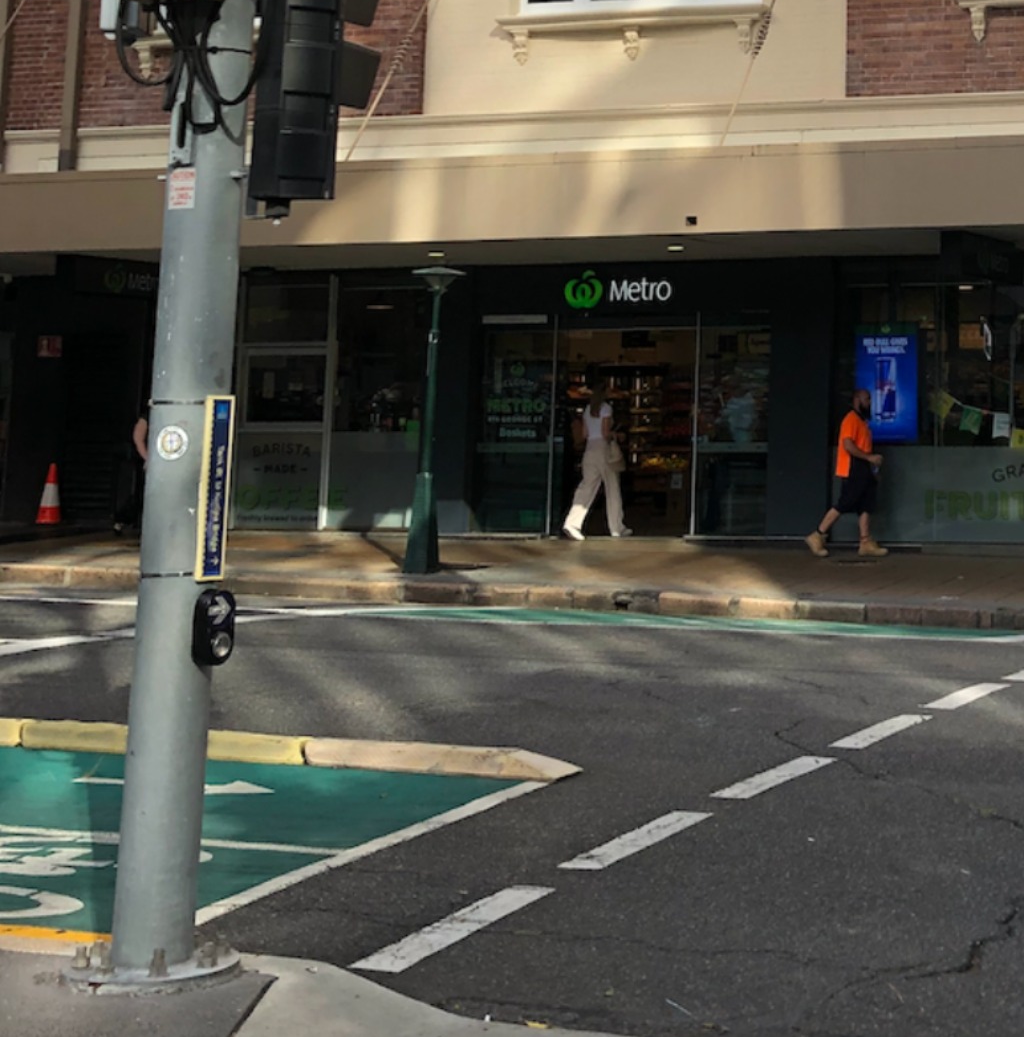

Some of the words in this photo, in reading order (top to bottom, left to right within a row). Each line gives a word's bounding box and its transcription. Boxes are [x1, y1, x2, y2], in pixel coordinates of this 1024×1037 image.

[609, 277, 672, 302] Metro
[486, 397, 547, 414] METRO
[252, 443, 311, 458] BARISTA
[263, 464, 298, 474] MADE
[236, 483, 350, 511] OFFEE
